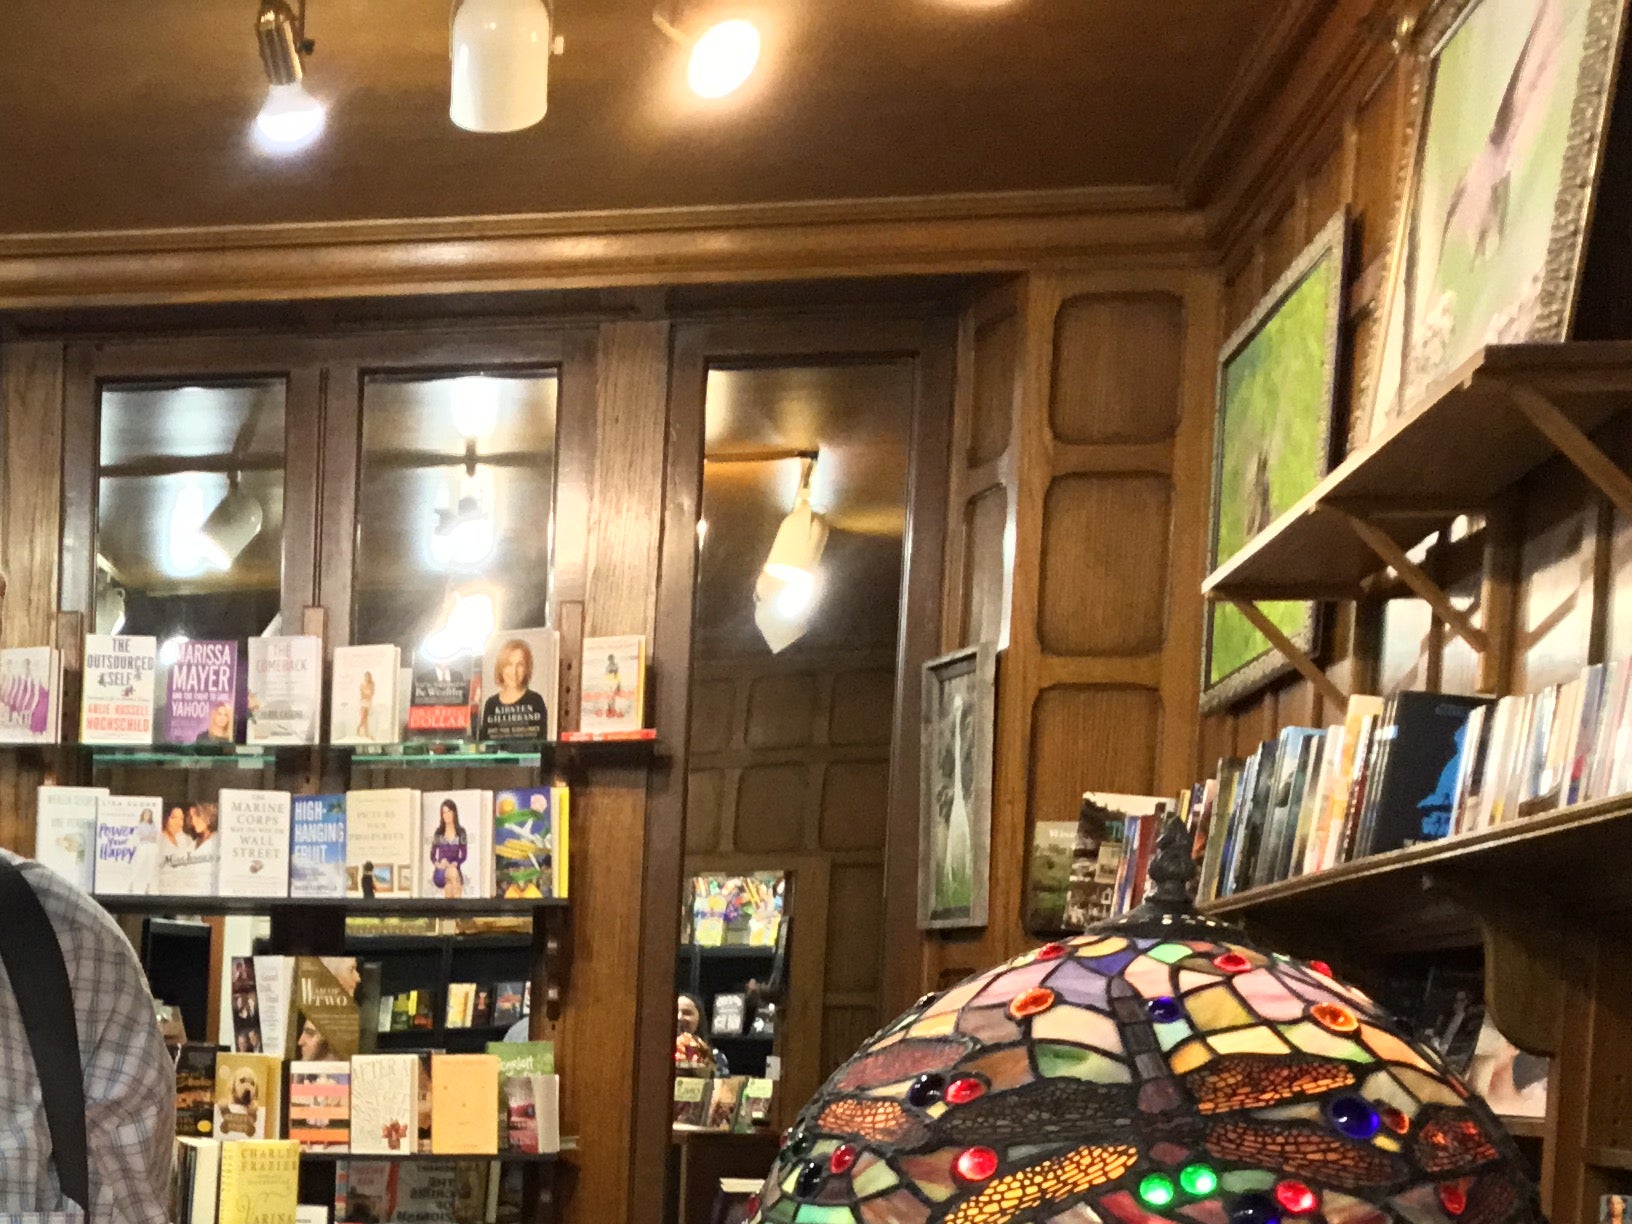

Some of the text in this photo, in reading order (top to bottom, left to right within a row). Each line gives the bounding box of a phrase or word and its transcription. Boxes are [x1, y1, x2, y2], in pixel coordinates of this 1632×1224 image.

[112, 638, 130, 653] THE
[87, 654, 154, 671] OUTSOURCED
[108, 671, 133, 686] SELF
[172, 665, 230, 691] MAYER
[172, 701, 209, 718] YAHOO!
[231, 802, 285, 814] MARINE
[294, 801, 327, 821] HIGH-
[236, 815, 279, 825] CORPS
[294, 822, 344, 843] HANGING
[240, 836, 274, 847] WALL
[99, 846, 137, 865] Happy
[232, 848, 281, 859] STREET
[294, 845, 327, 863] FRUIT
[313, 994, 348, 1007] TWO
